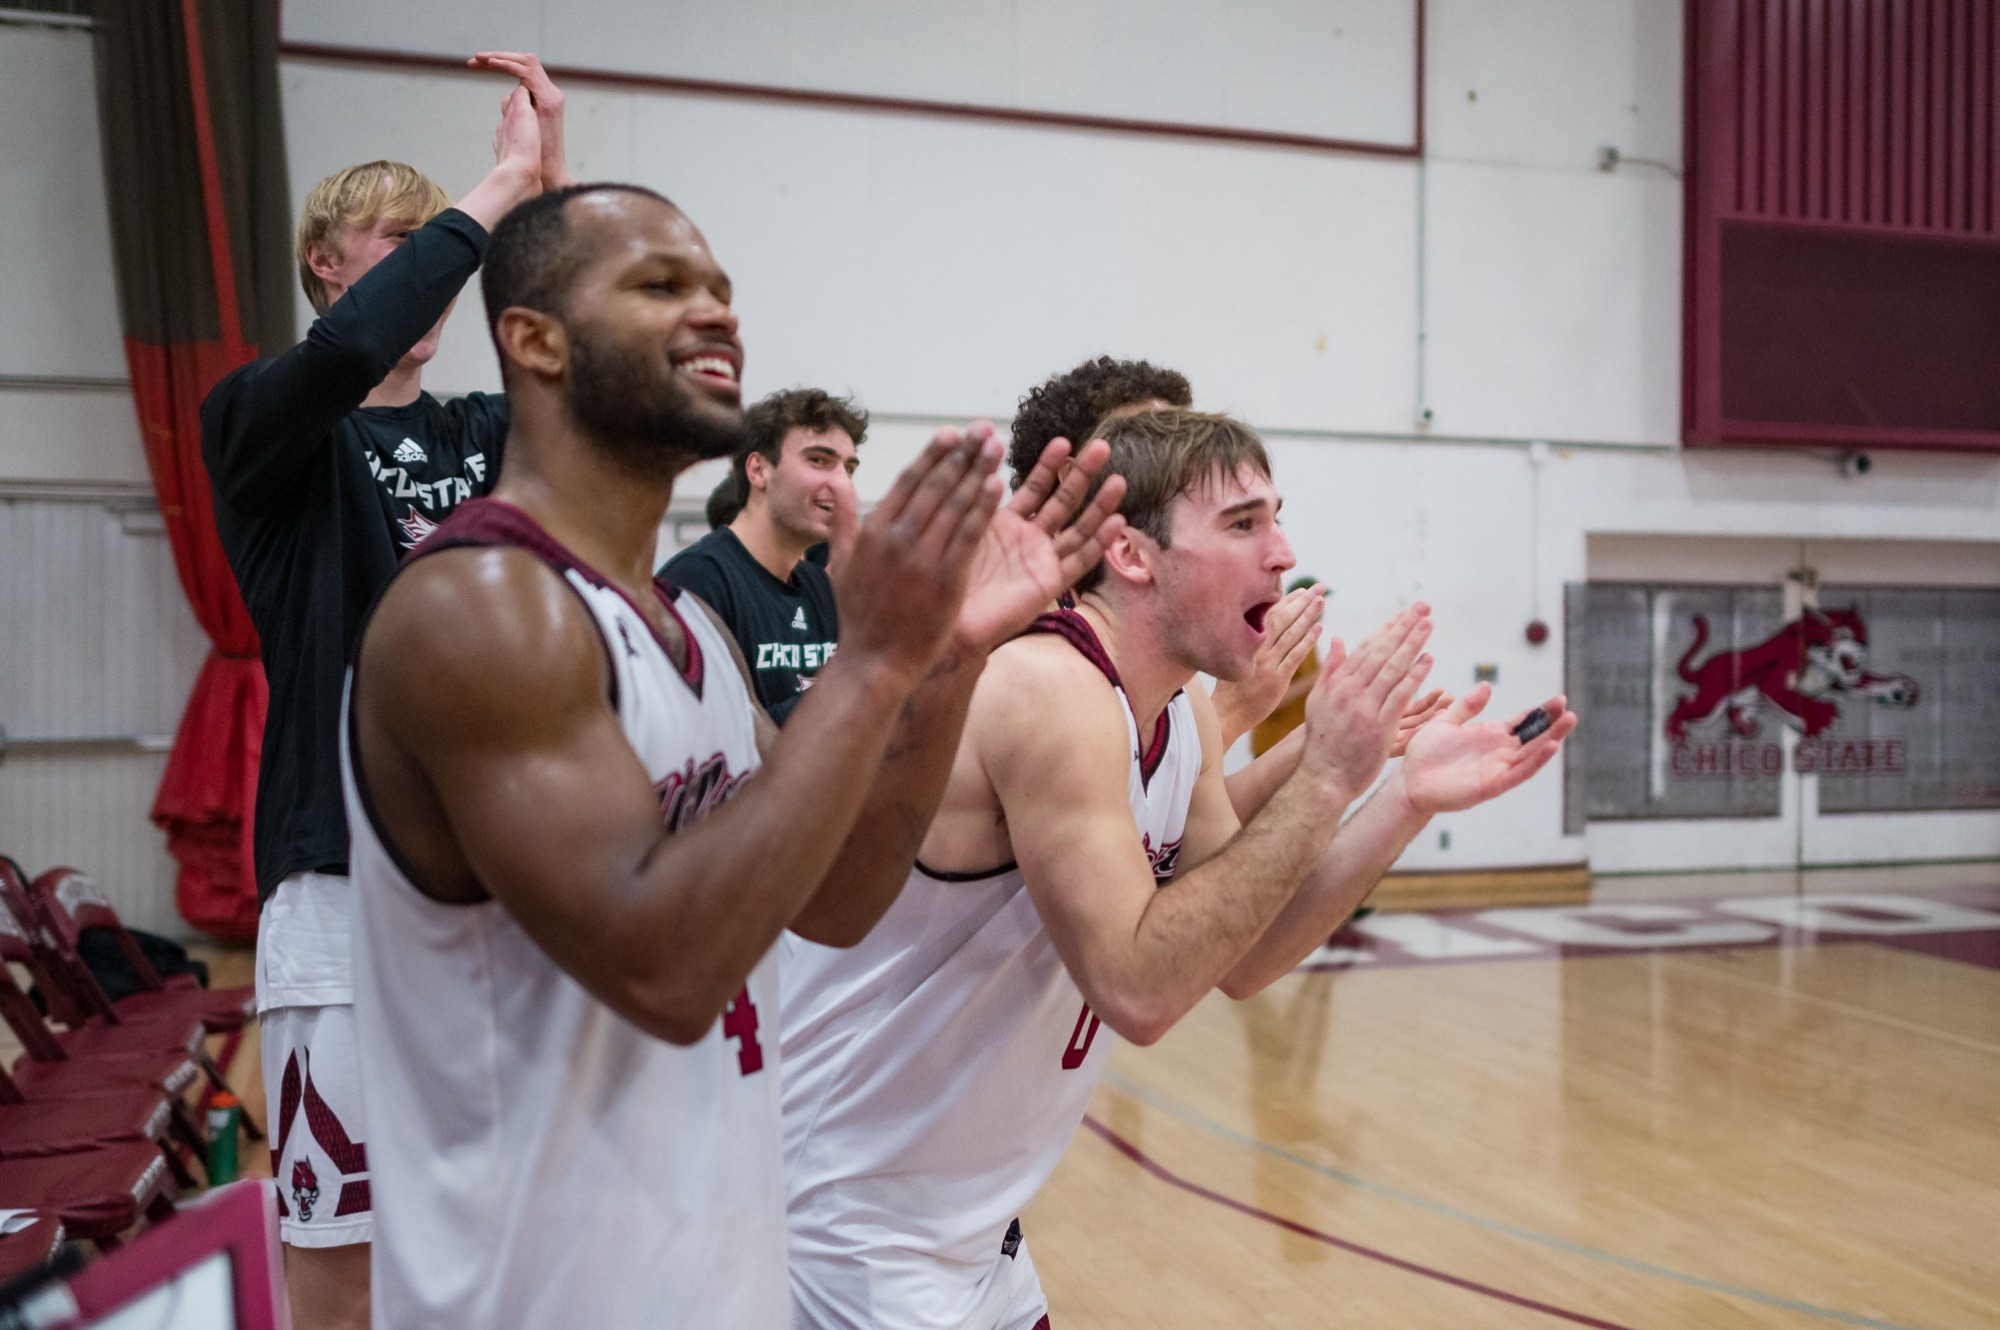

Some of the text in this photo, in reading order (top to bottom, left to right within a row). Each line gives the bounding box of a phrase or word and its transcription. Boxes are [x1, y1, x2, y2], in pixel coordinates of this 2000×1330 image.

[1670, 740, 1905, 777] CHICO STATE
[723, 982, 763, 1076] 4
